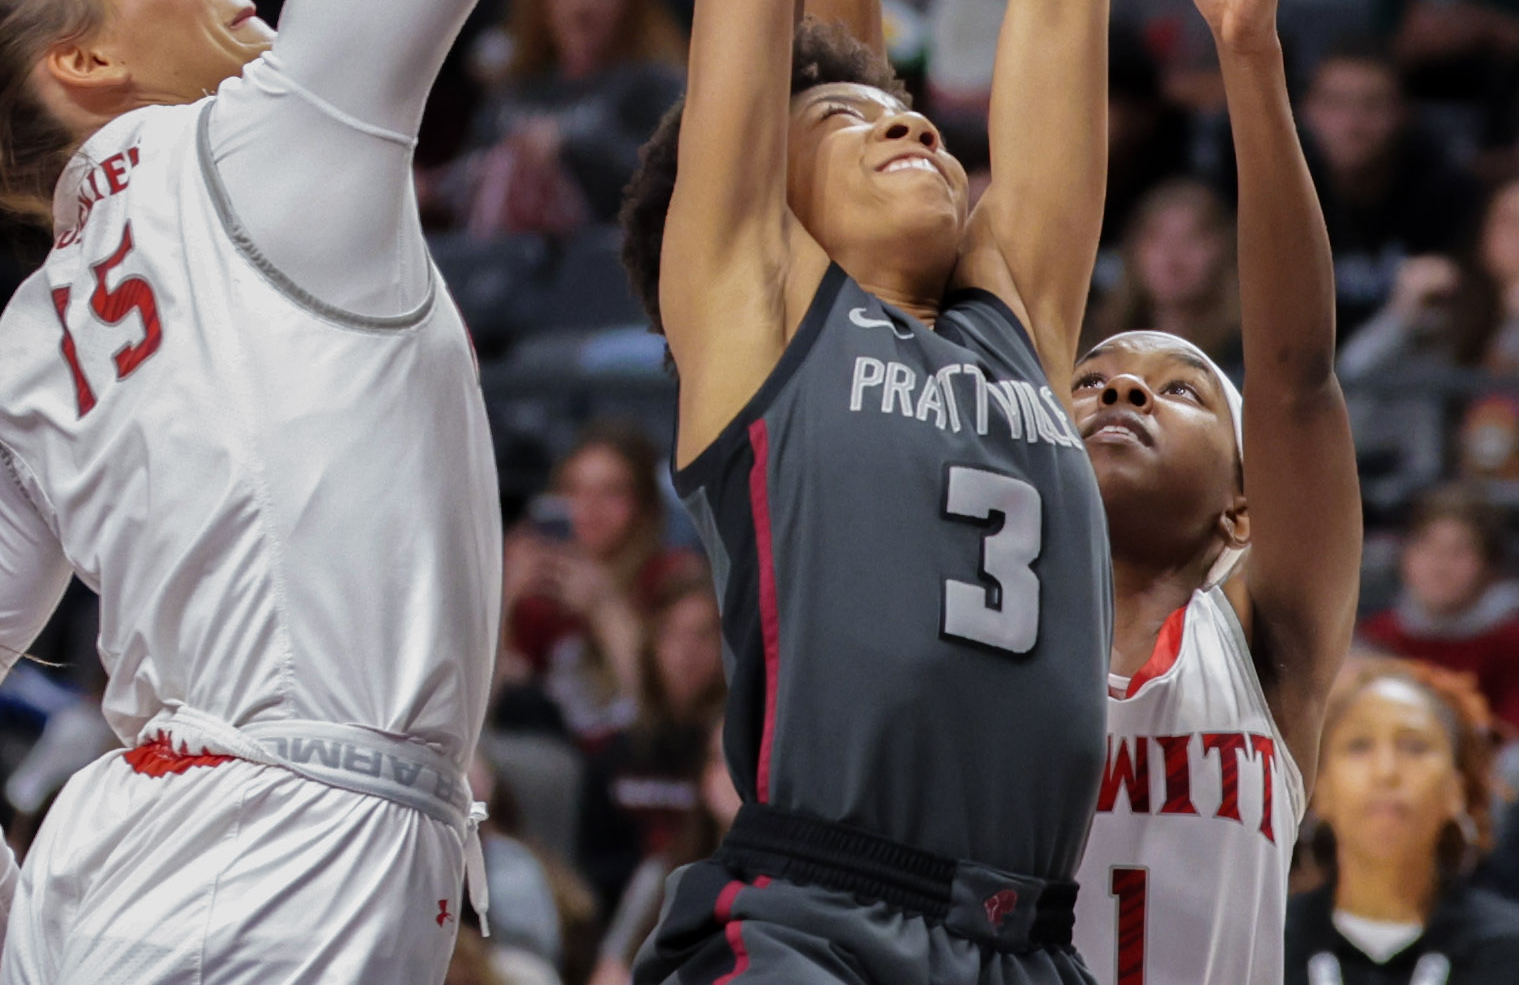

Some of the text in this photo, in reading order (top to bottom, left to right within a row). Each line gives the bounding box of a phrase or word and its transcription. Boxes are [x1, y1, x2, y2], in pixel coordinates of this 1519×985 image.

[51, 218, 164, 421] 15
[941, 464, 1043, 655] 3
[1096, 733, 1277, 846] WITT
[1108, 864, 1150, 985] 1
